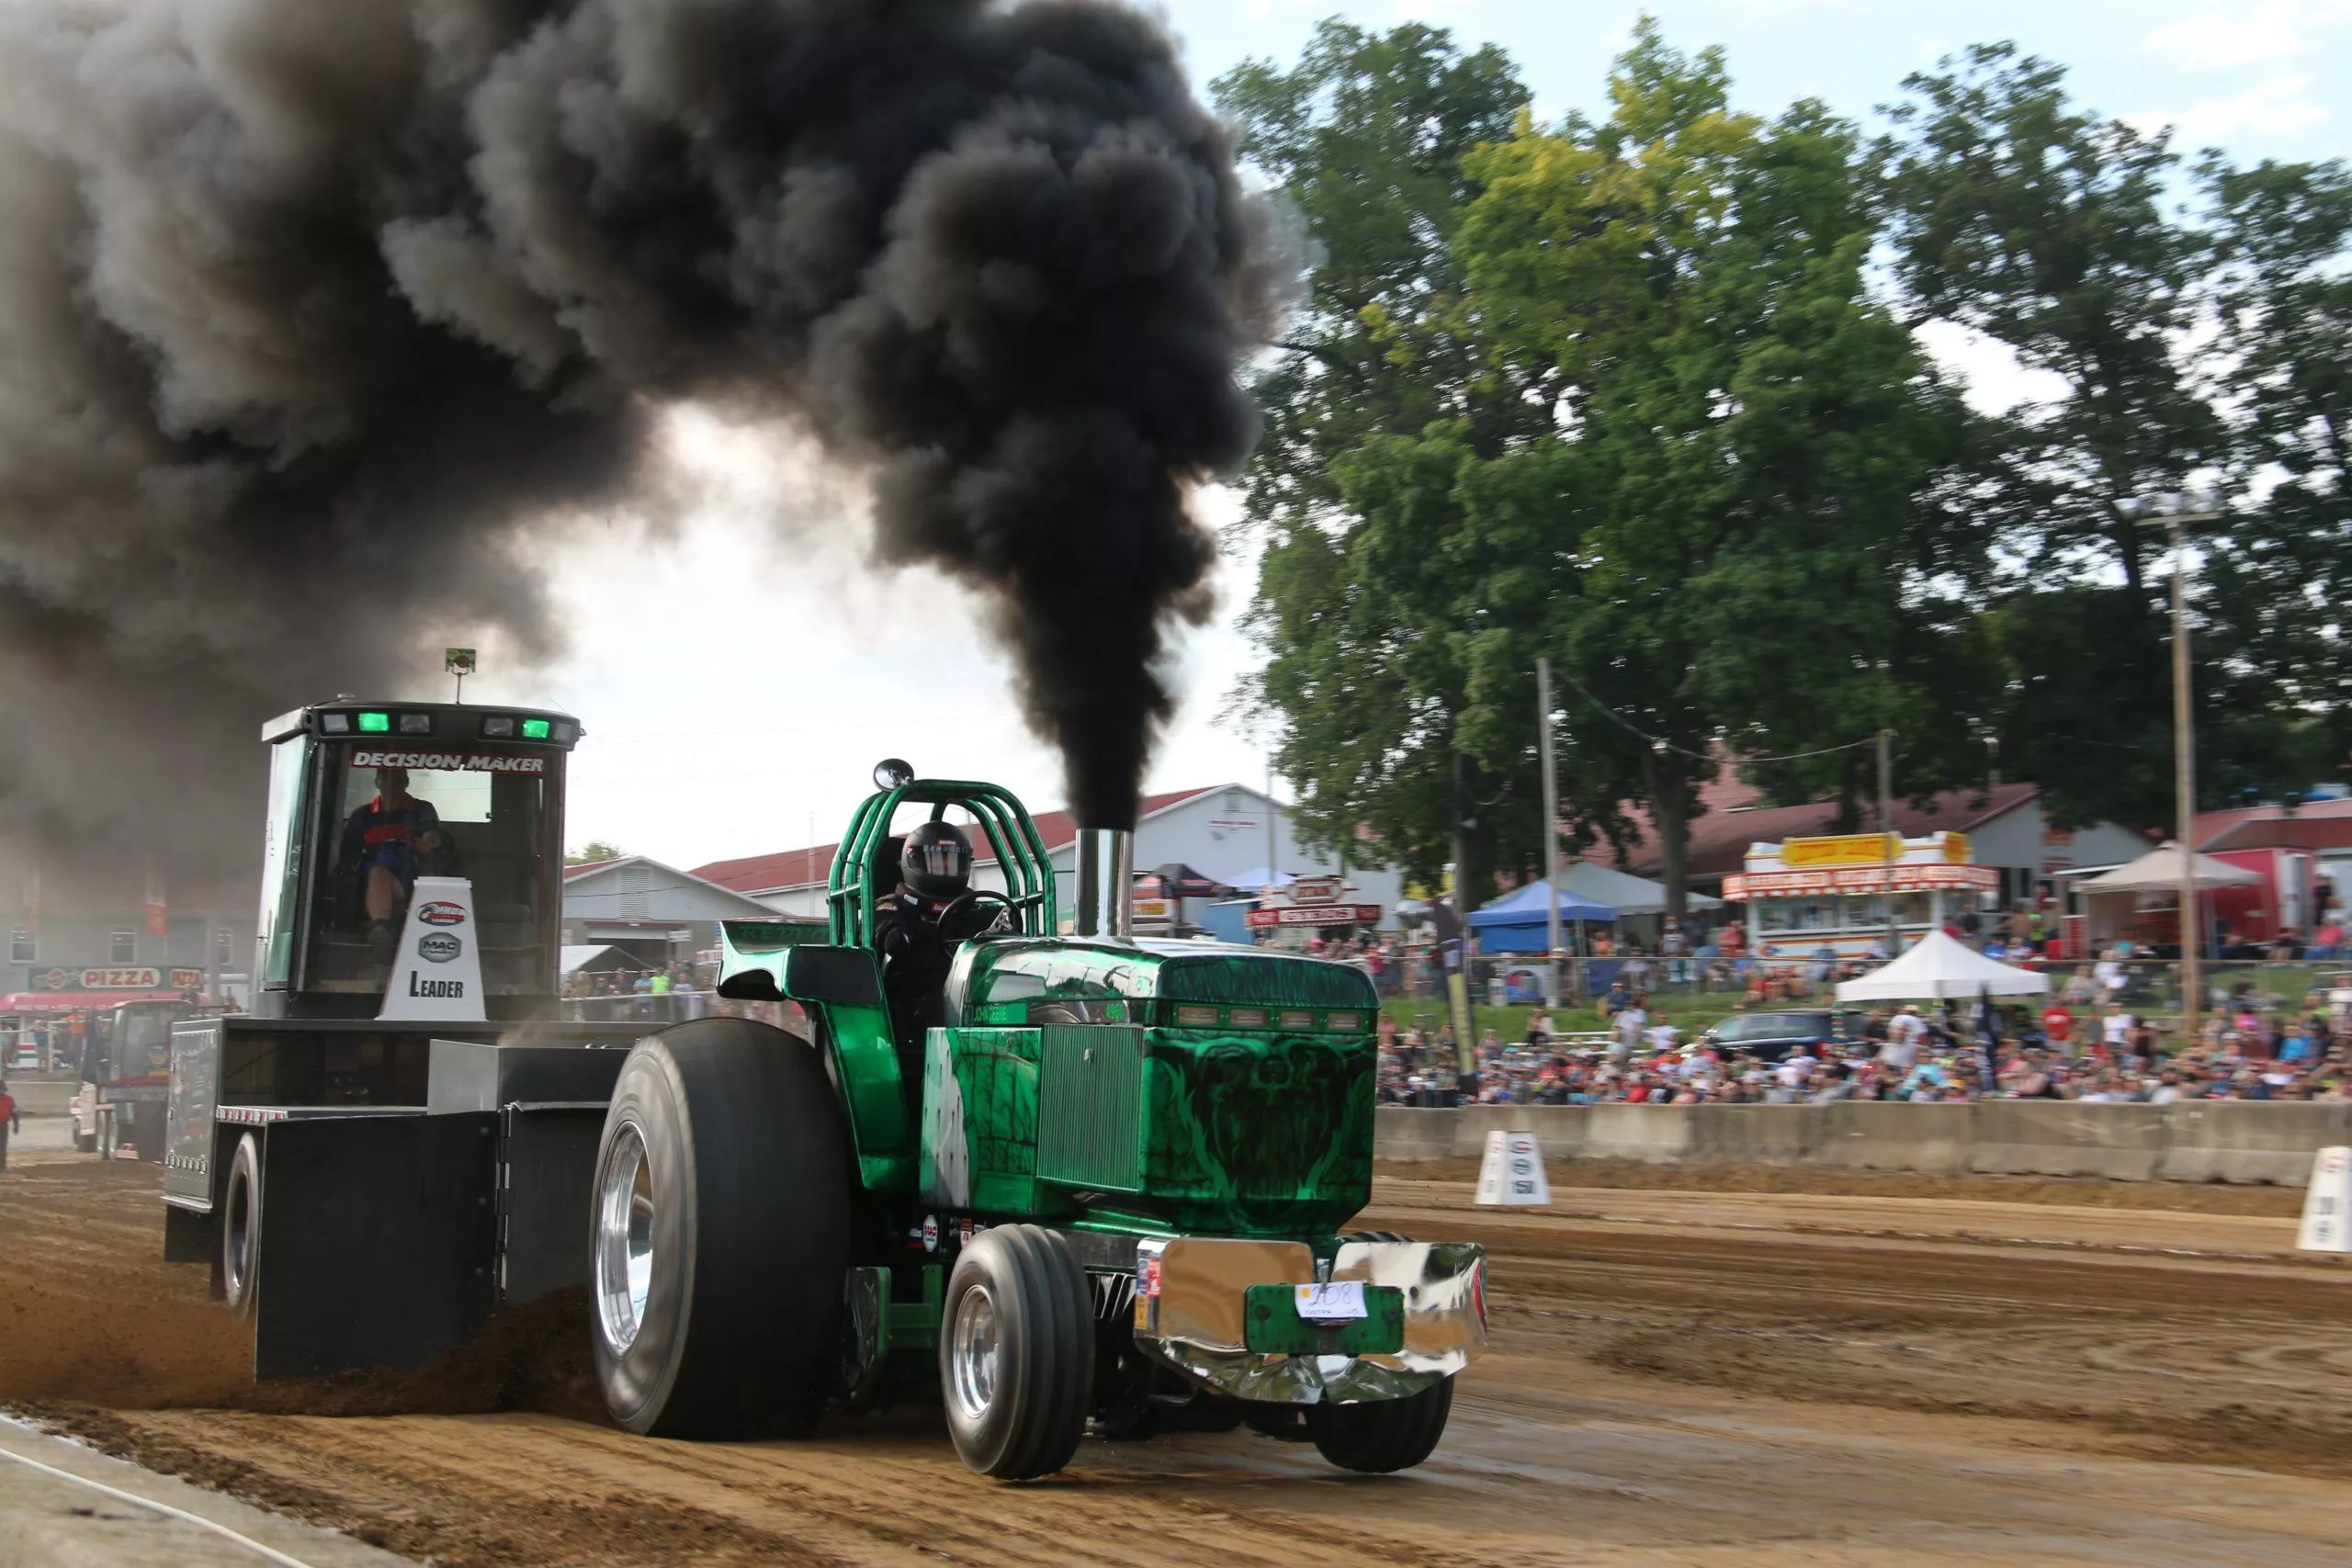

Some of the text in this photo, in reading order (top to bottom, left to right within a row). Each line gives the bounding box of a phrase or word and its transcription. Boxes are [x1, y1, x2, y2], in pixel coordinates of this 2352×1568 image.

[353, 752, 544, 772] DECISION MAKER
[423, 941, 458, 951] MAC
[85, 970, 156, 986] PIZZA
[974, 1006, 1008, 1022] JOHN DEERE
